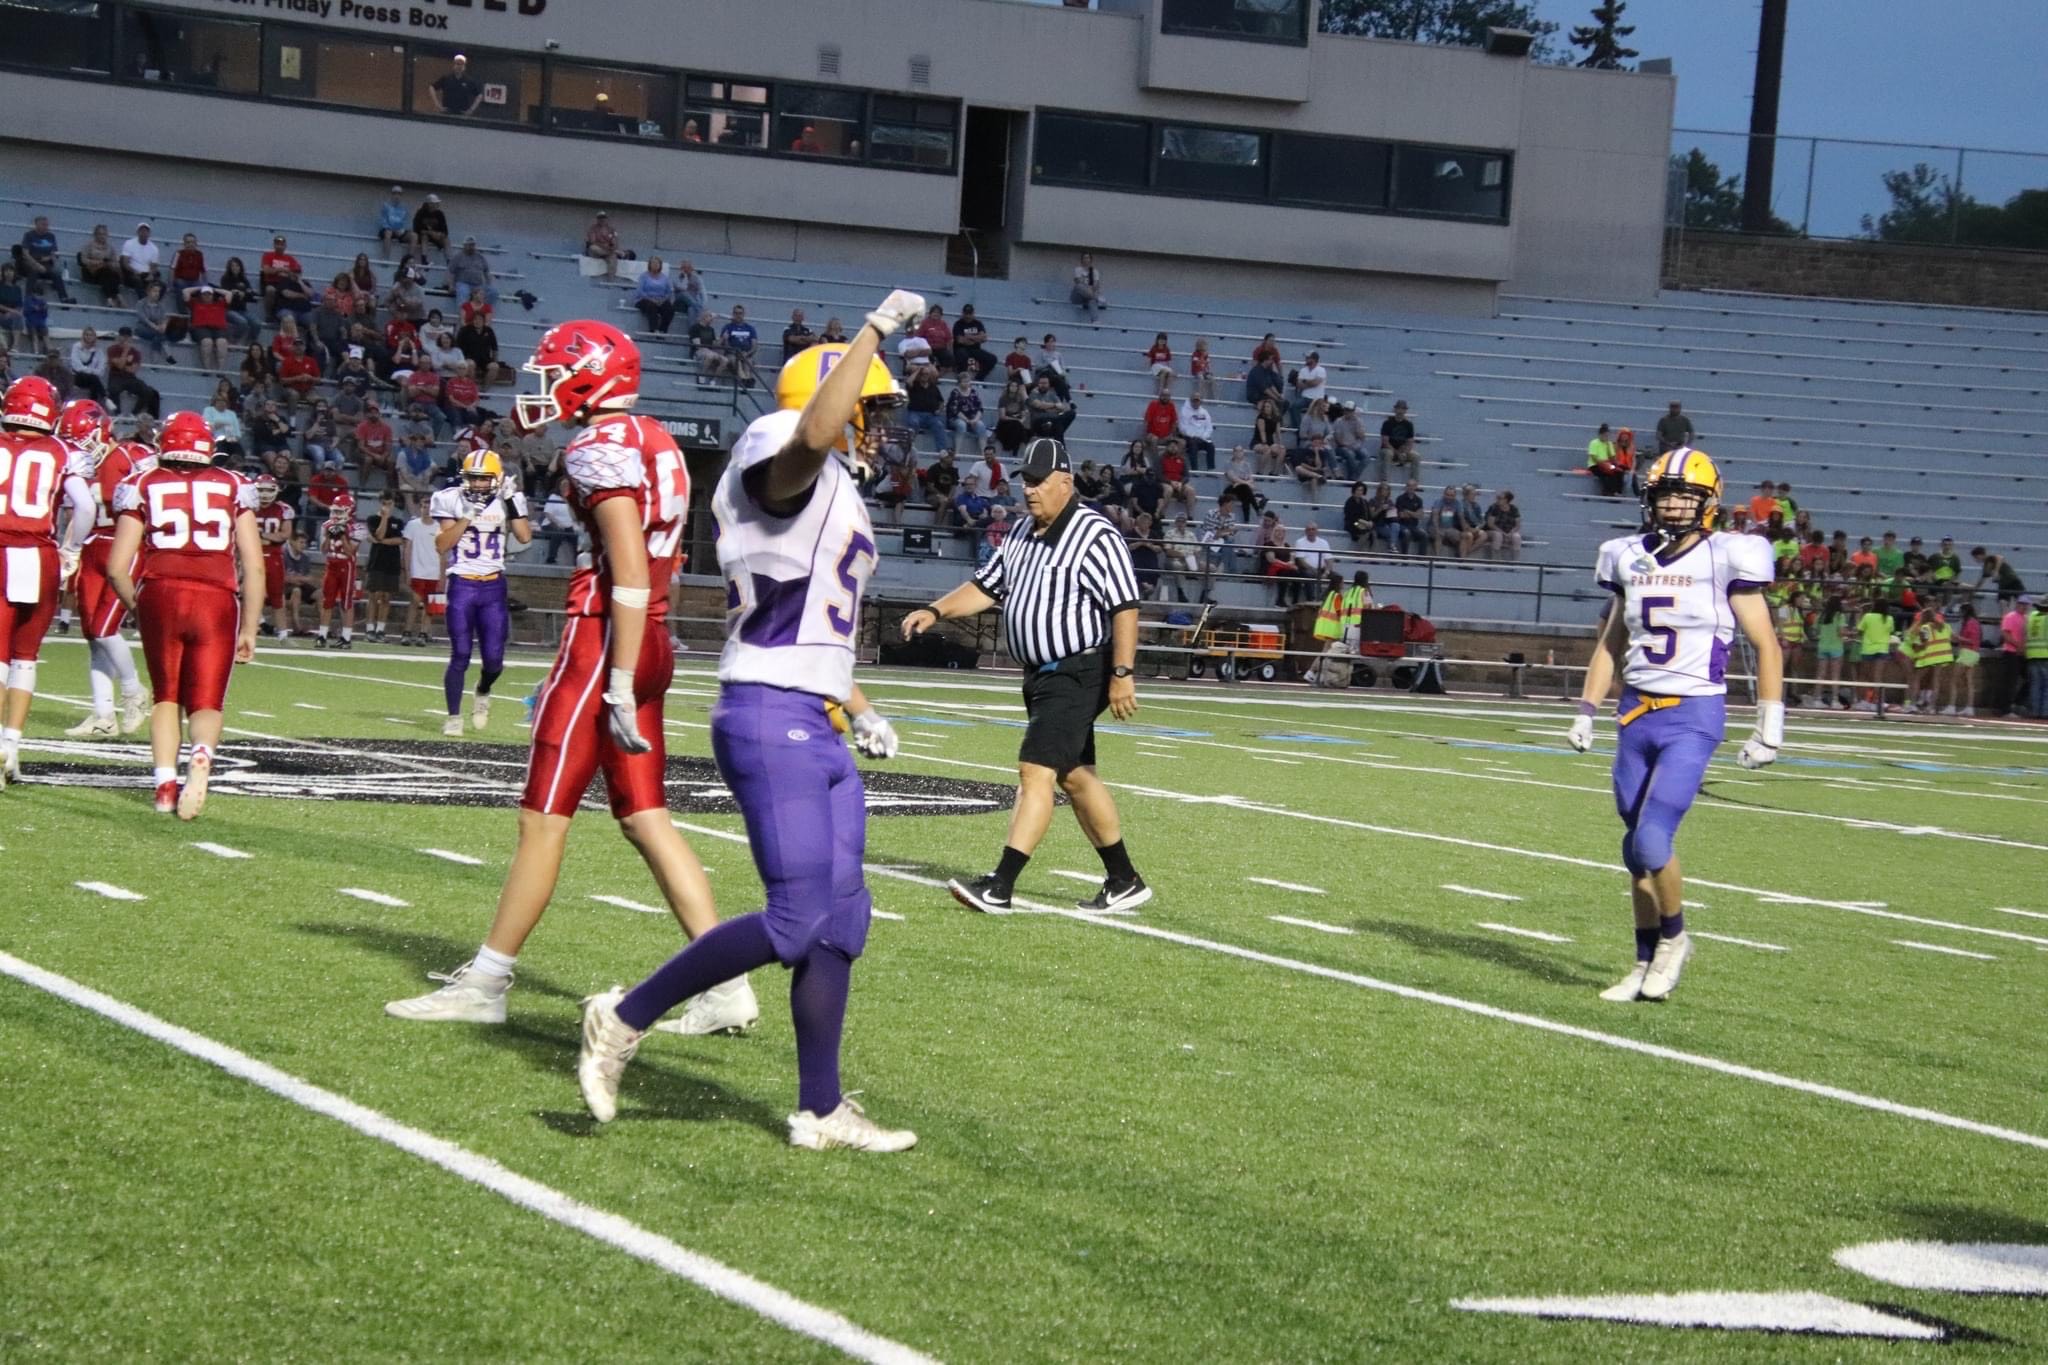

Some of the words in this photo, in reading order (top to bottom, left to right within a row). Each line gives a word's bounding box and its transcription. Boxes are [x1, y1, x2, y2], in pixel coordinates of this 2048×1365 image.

[340, 0, 400, 23] Press
[408, 7, 448, 30] Box
[147, 482, 231, 550] 55
[463, 525, 501, 560] 34
[1631, 574, 1693, 588] PANTHERS
[1640, 595, 1679, 666] 5
